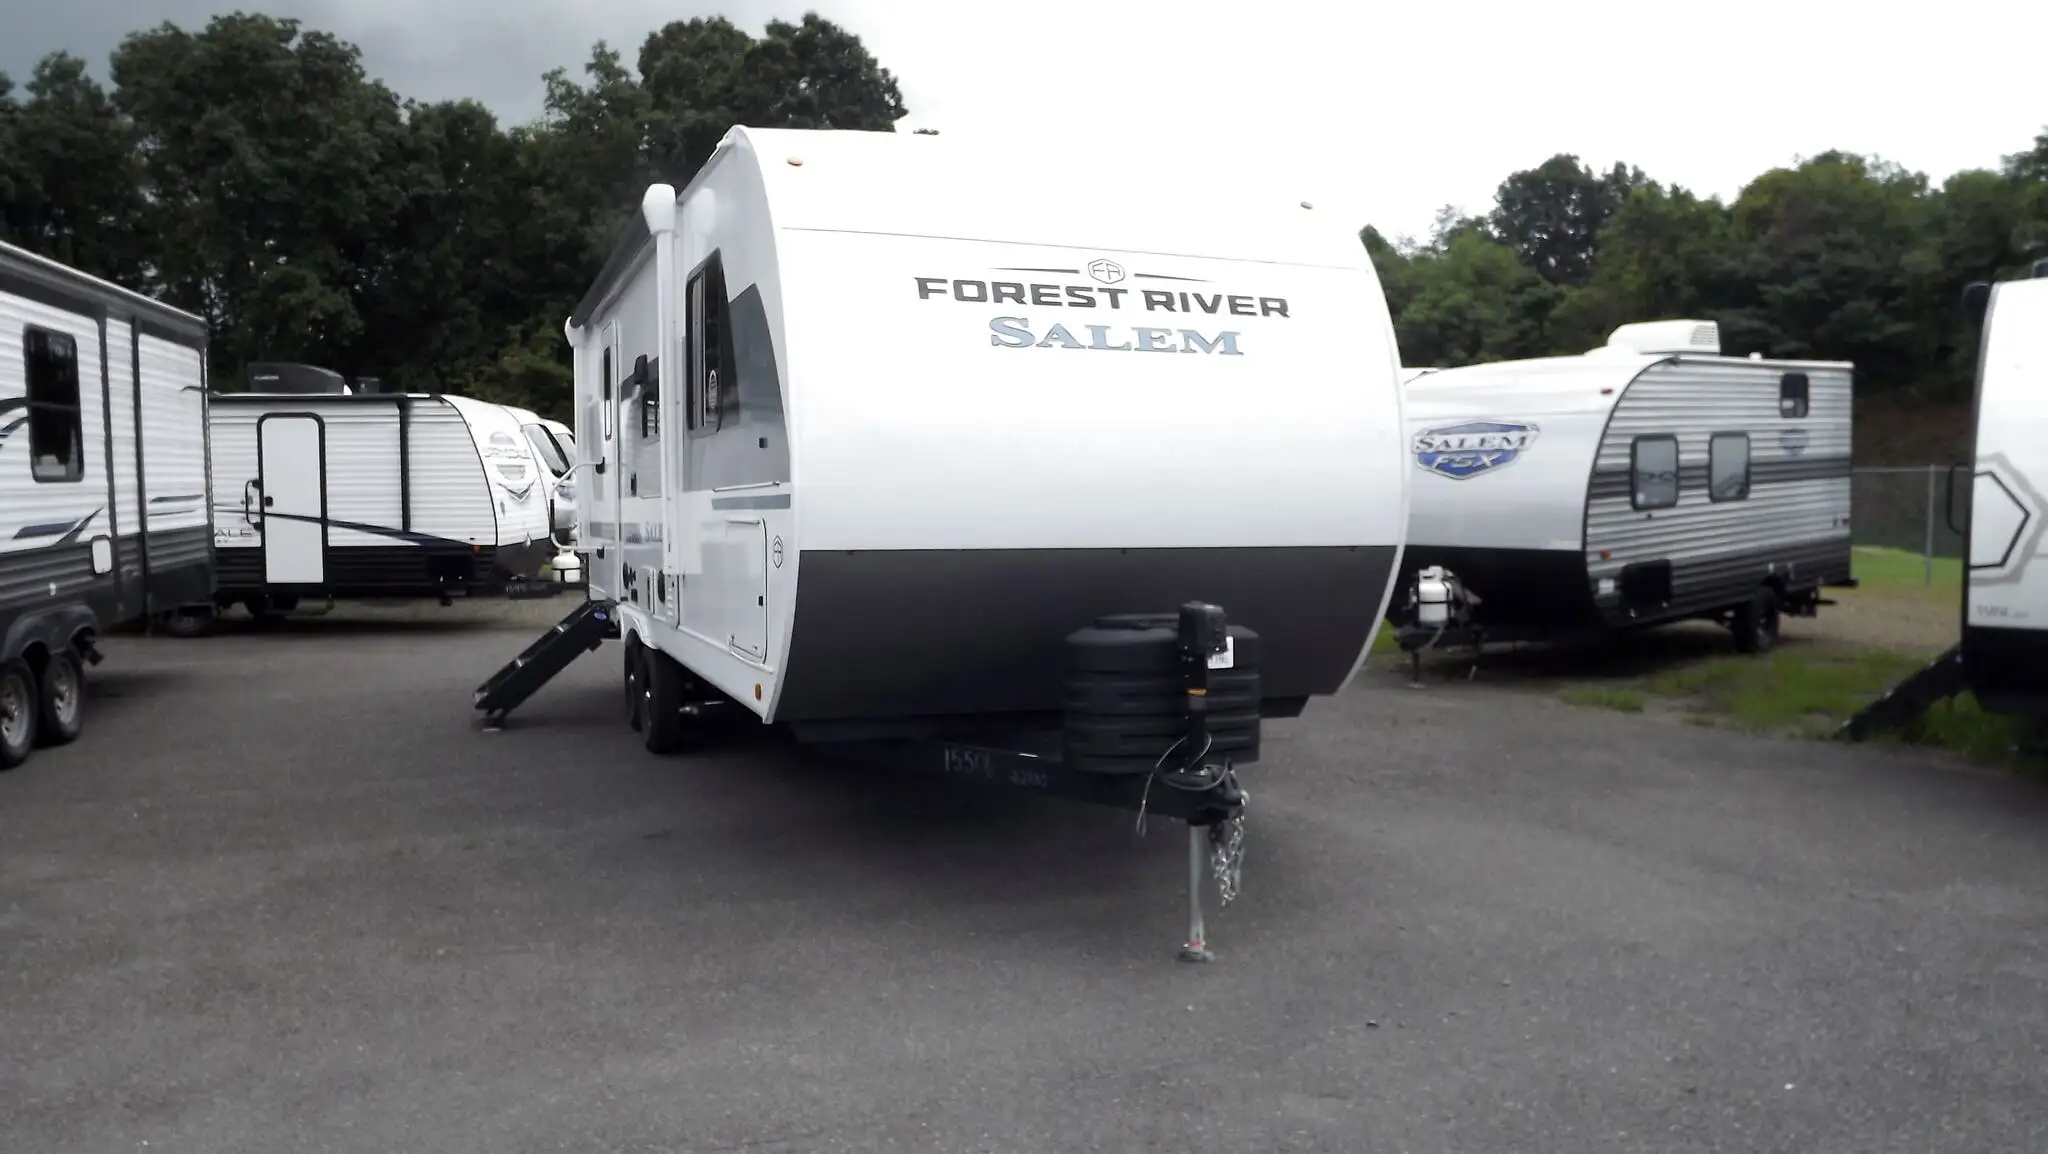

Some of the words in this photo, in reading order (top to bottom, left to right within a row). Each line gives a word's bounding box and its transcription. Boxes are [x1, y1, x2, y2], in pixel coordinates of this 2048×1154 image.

[914, 277, 1128, 309] FOREST
[1140, 289, 1291, 318] RIVER
[988, 316, 1245, 356] SALEM
[1414, 434, 1529, 452] SALEM
